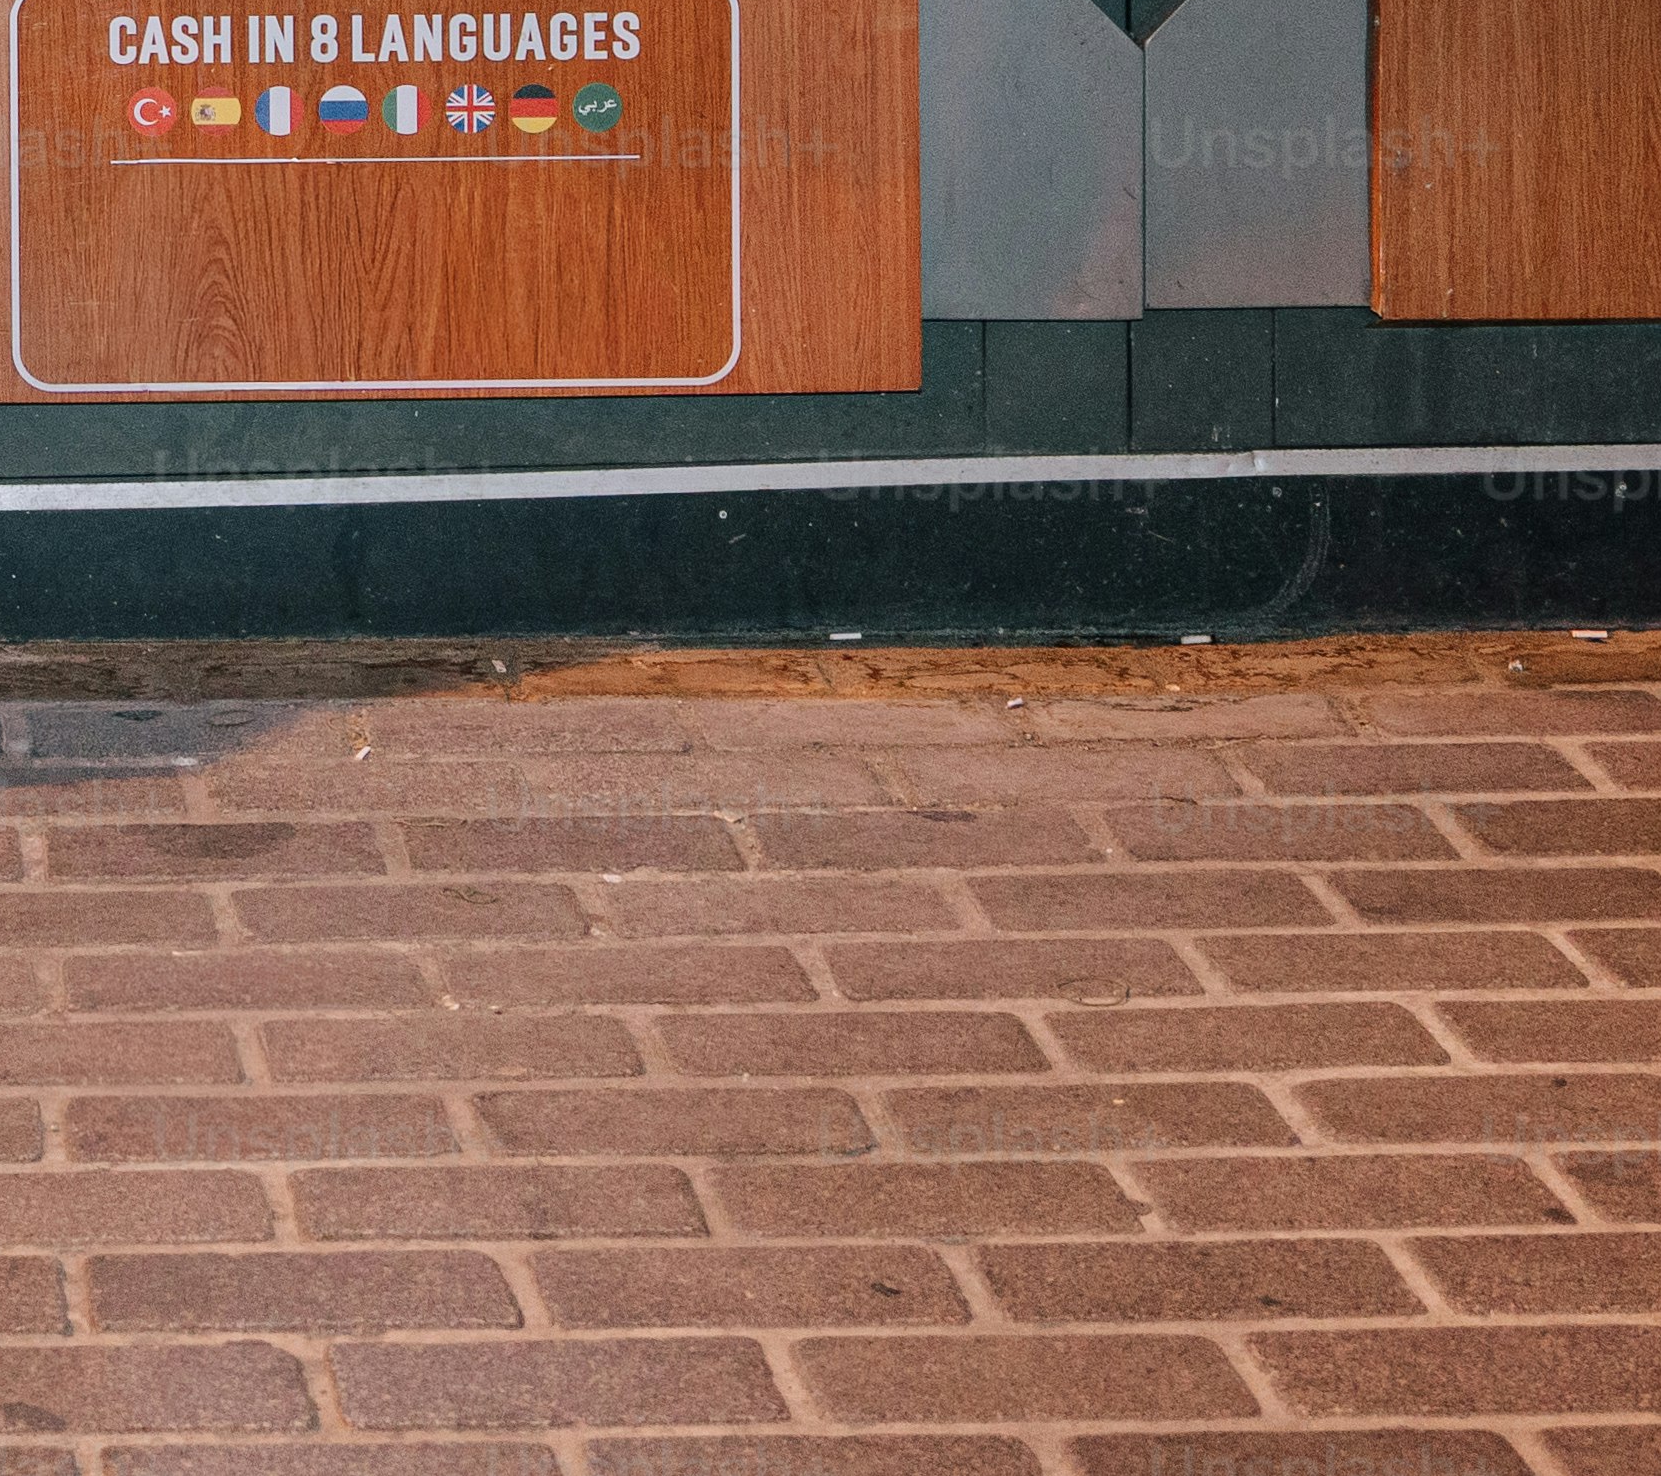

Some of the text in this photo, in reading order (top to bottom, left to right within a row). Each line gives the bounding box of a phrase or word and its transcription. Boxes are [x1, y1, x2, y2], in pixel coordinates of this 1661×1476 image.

[108, 11, 641, 65] CASH IN 8 LANGUAGES
[578, 98, 617, 116] عربي
